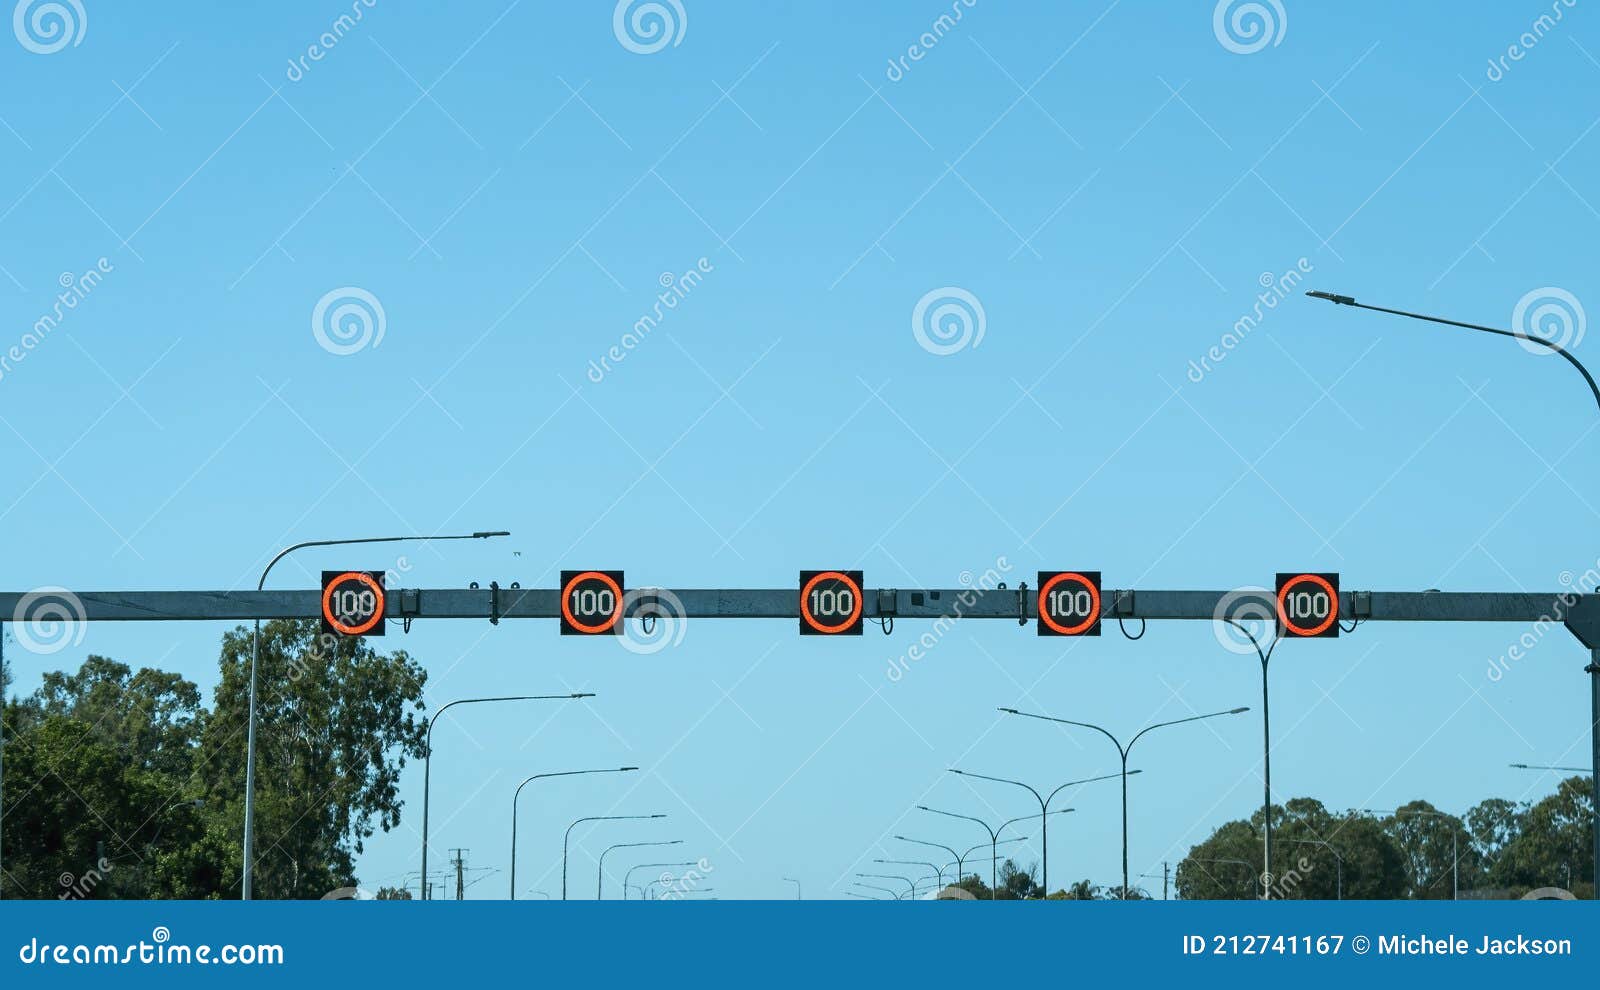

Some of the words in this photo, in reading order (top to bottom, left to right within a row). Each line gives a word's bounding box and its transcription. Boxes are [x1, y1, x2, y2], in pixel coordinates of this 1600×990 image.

[333, 590, 375, 616] 100
[572, 590, 614, 616] 100
[811, 590, 853, 616] 100
[1049, 590, 1091, 617] 100
[1287, 592, 1329, 618] 100
